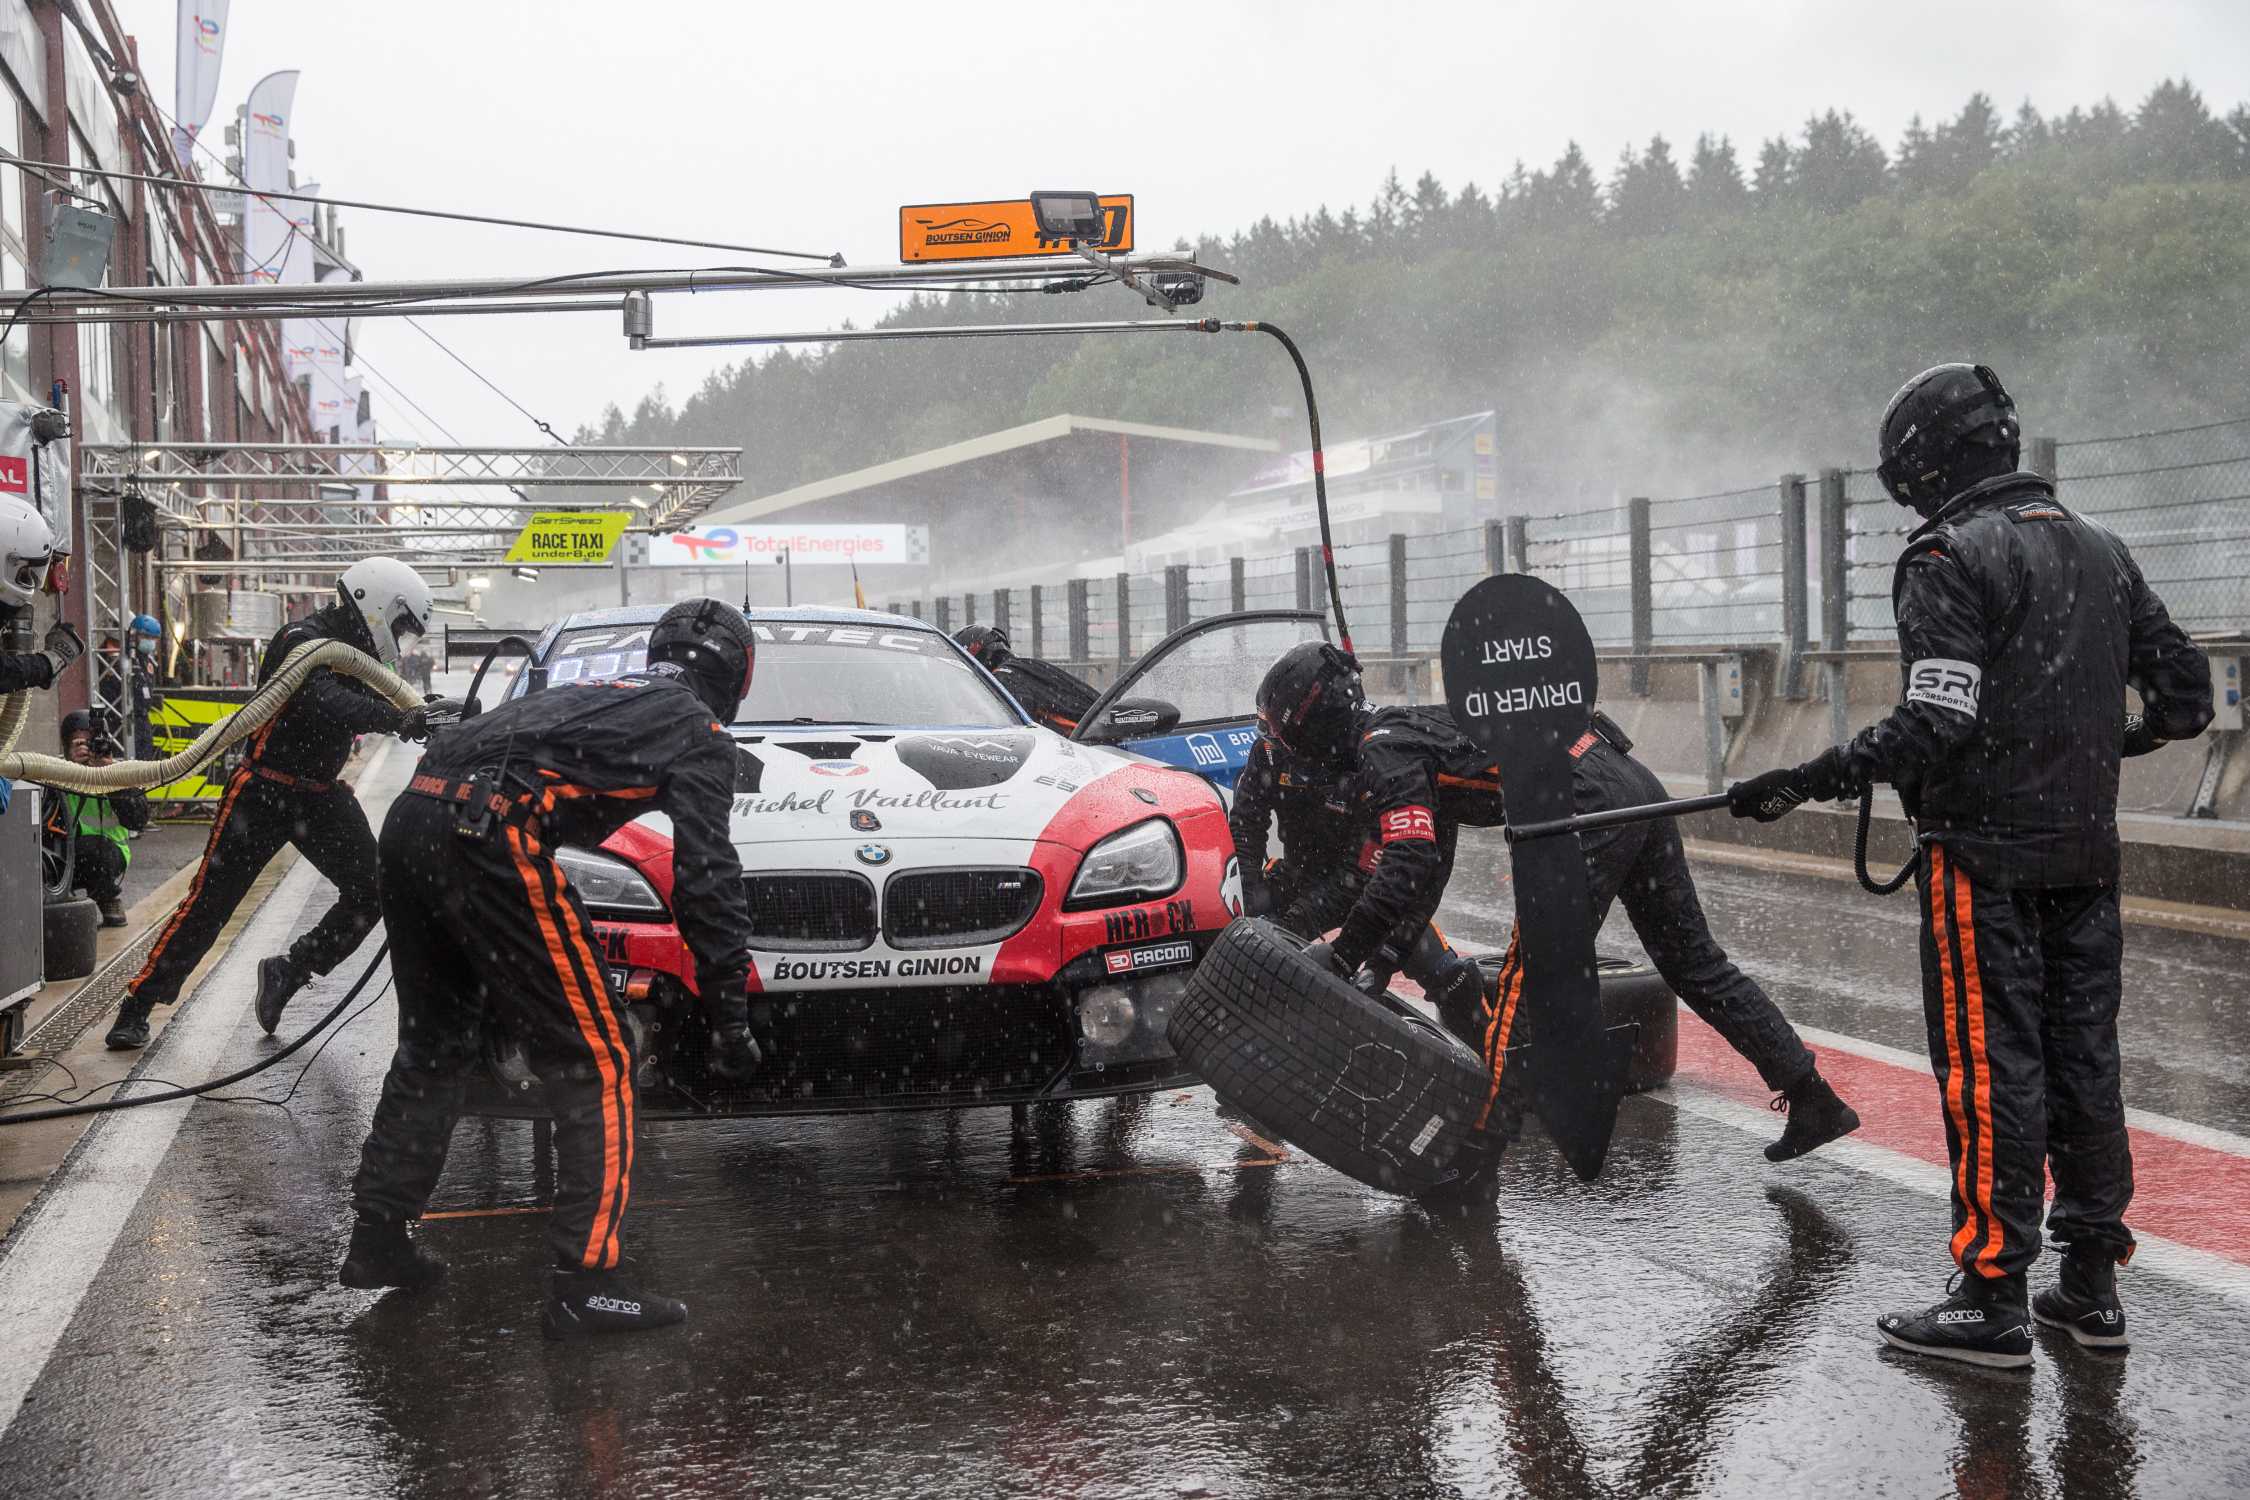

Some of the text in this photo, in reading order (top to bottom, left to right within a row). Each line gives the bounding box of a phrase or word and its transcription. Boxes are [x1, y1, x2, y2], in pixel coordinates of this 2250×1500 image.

[927, 231, 1011, 242] BOUTSEN GINION
[532, 533, 604, 549] RACE TAXI
[744, 535, 884, 556] TotalEnergies
[532, 550, 604, 558] under8.de
[1482, 636, 1552, 664] START
[1466, 682, 1582, 717] DRIVER ID
[963, 750, 1020, 763] EYEWEAR
[456, 782, 512, 817] HECK
[733, 787, 1010, 816] Michel Vaillant
[1133, 945, 1190, 965] FACOM
[774, 956, 981, 980] BOUTSEN GINION
[588, 1296, 641, 1312] sparco
[1937, 1309, 1984, 1324] sparco
